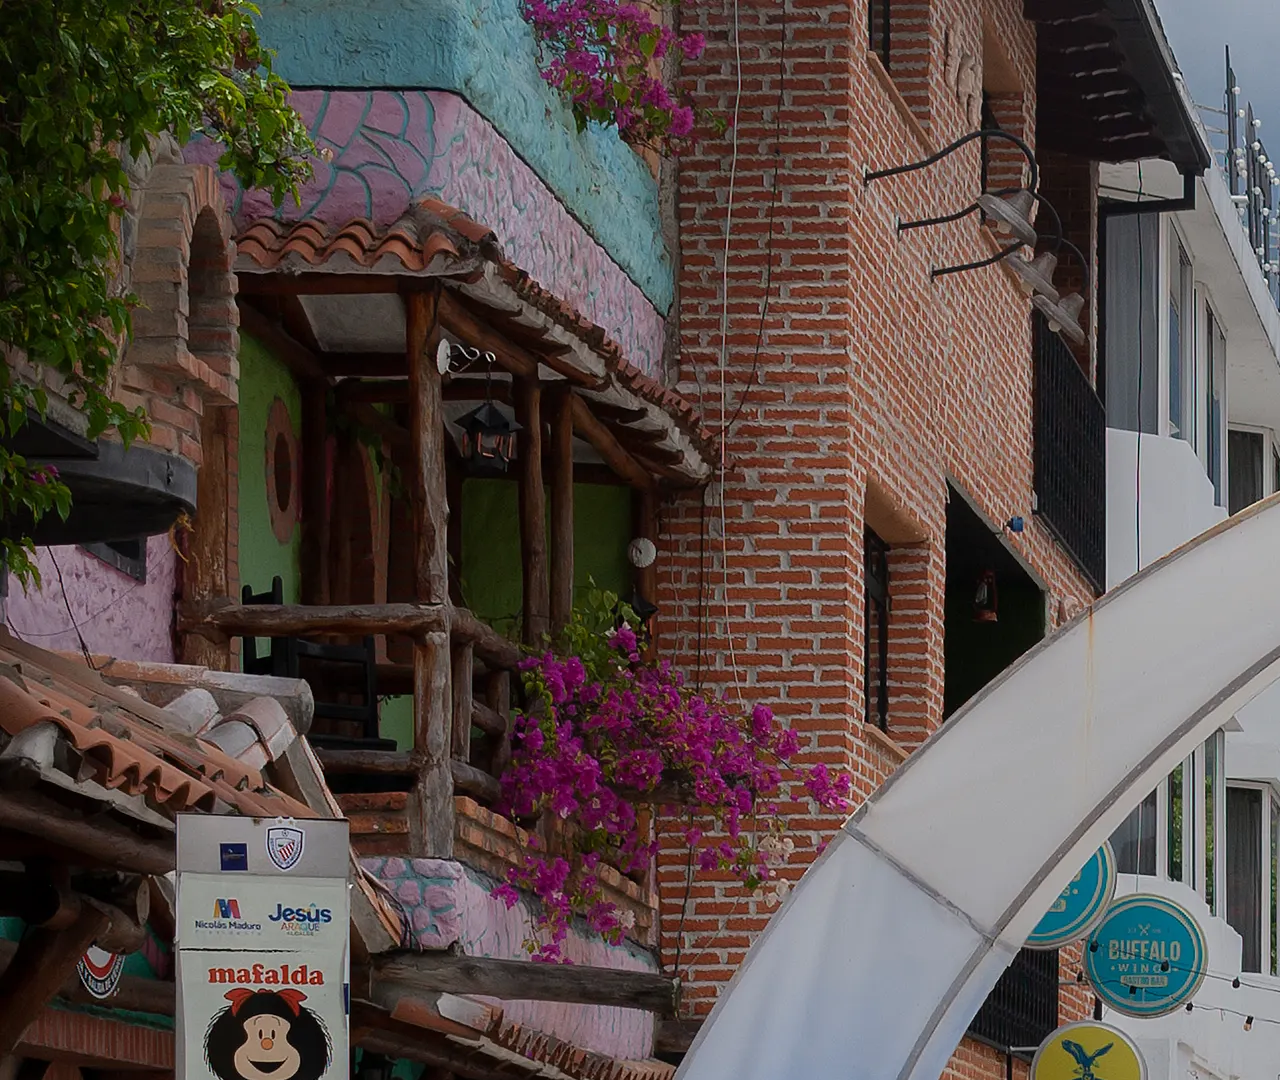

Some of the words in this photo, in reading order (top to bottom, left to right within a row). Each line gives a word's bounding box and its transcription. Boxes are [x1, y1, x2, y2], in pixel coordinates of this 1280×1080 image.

[229, 921, 261, 930] Maduro
[281, 922, 320, 932] ARAQUE
[1108, 939, 1181, 962] BUFFALO
[208, 963, 324, 985] mafalda
[1118, 963, 1171, 974] WING
